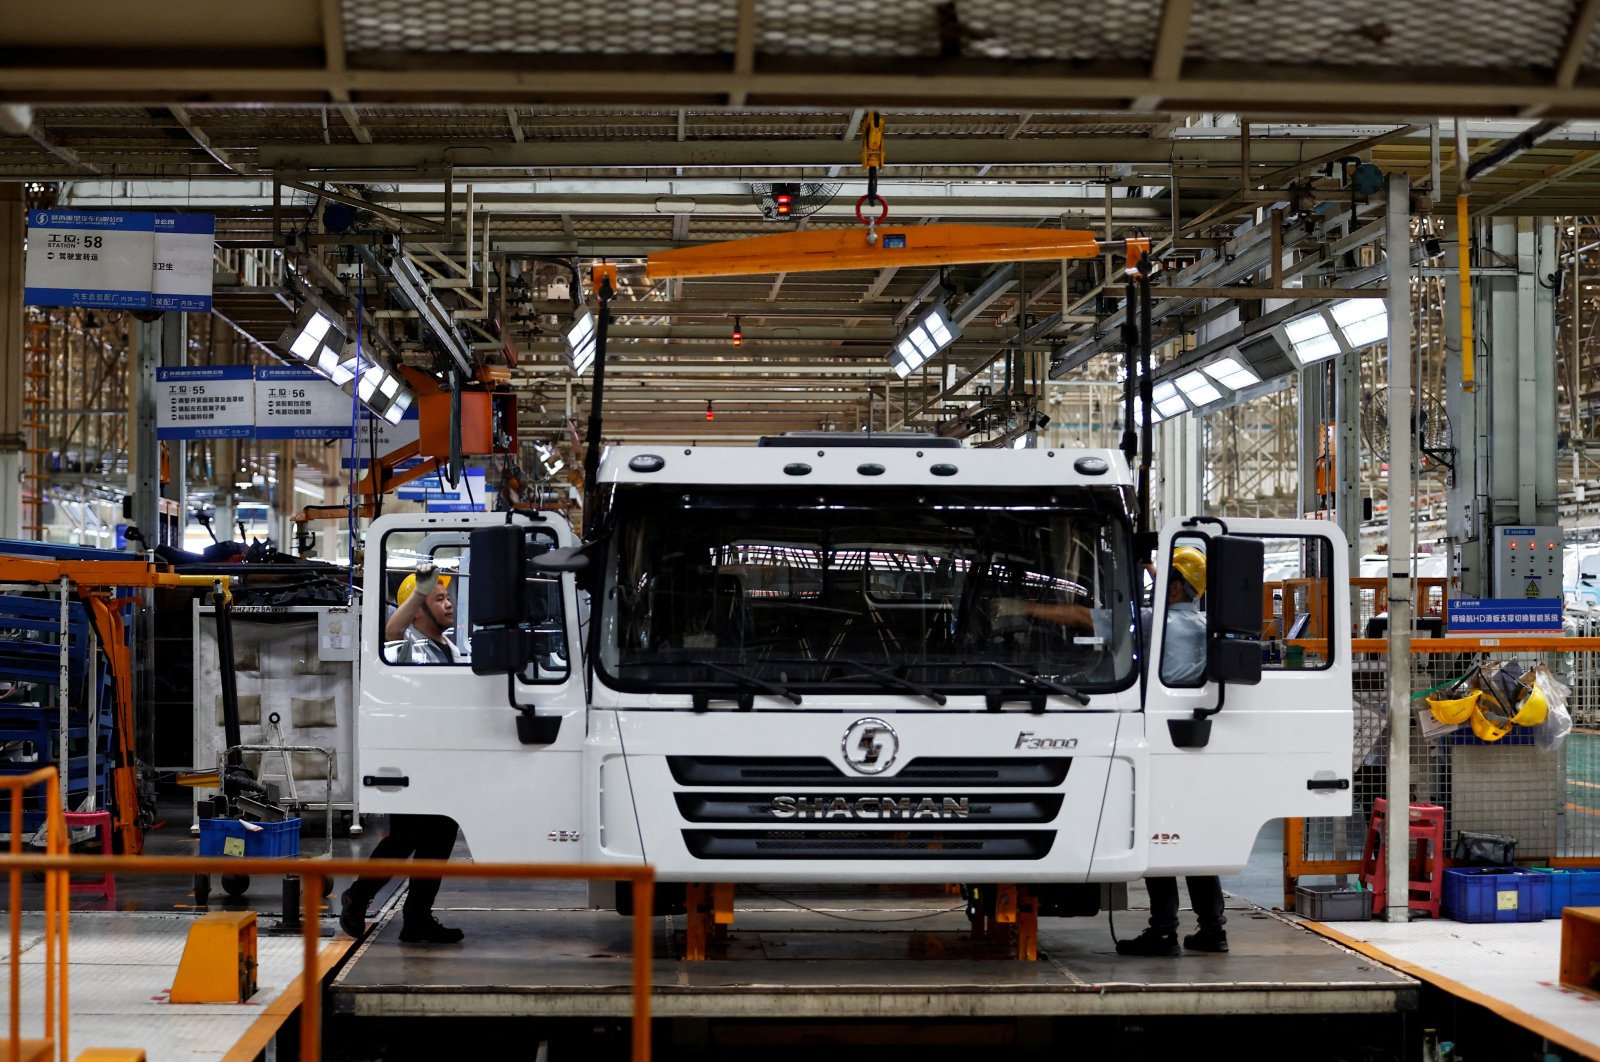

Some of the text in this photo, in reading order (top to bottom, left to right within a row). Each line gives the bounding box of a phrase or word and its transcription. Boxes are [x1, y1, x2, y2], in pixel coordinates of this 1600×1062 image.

[84, 235, 103, 249] 58
[58, 252, 99, 261] 驾驶室转运
[152, 298, 178, 306] 装配厂
[192, 385, 205, 395] 55
[292, 389, 305, 398] 56
[1015, 731, 1078, 750] F3000
[771, 796, 969, 819] SHACMAN
